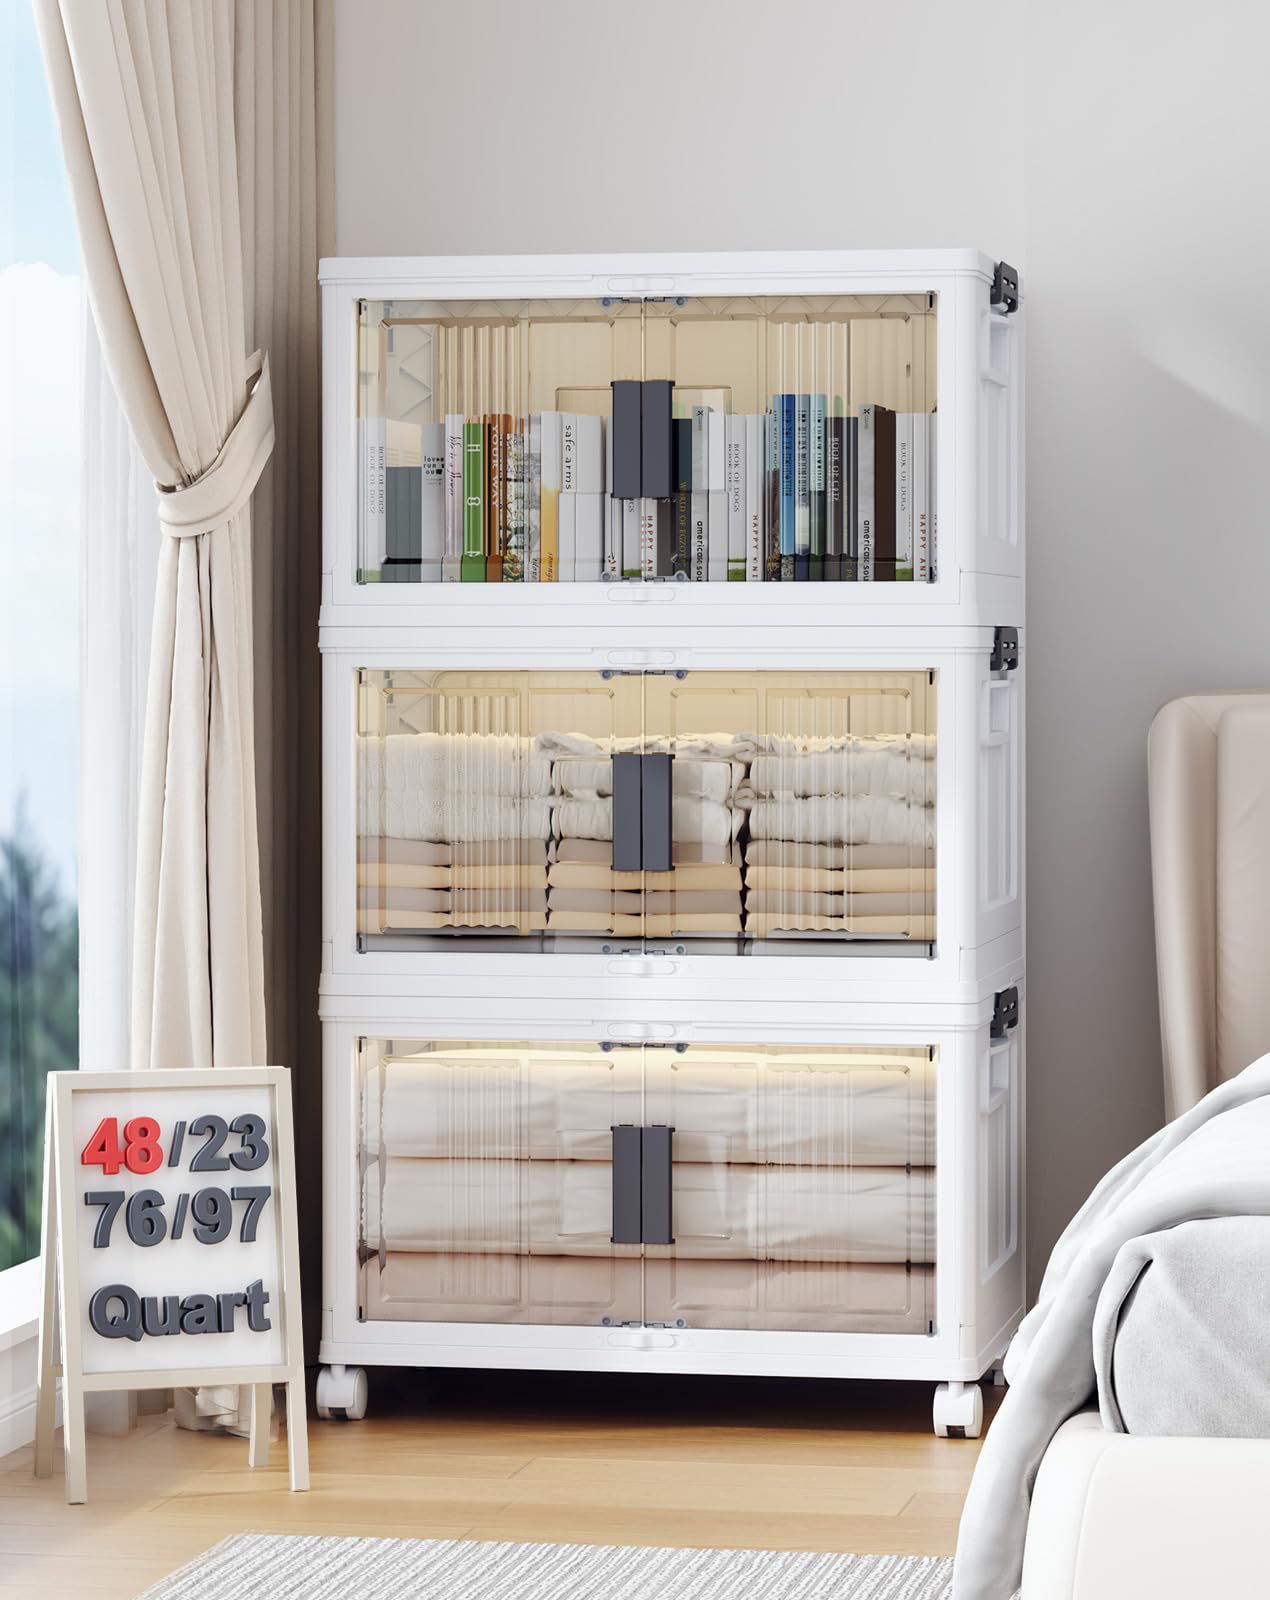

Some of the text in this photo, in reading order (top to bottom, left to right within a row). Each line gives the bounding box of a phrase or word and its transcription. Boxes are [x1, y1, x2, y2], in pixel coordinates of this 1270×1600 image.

[491, 424, 499, 508] YOUR WAY
[564, 424, 576, 490] safe arms
[733, 472, 740, 483] OF
[81, 1113, 270, 1176] 48/23
[84, 1186, 272, 1249] 76/97
[89, 1279, 272, 1342] Quart
